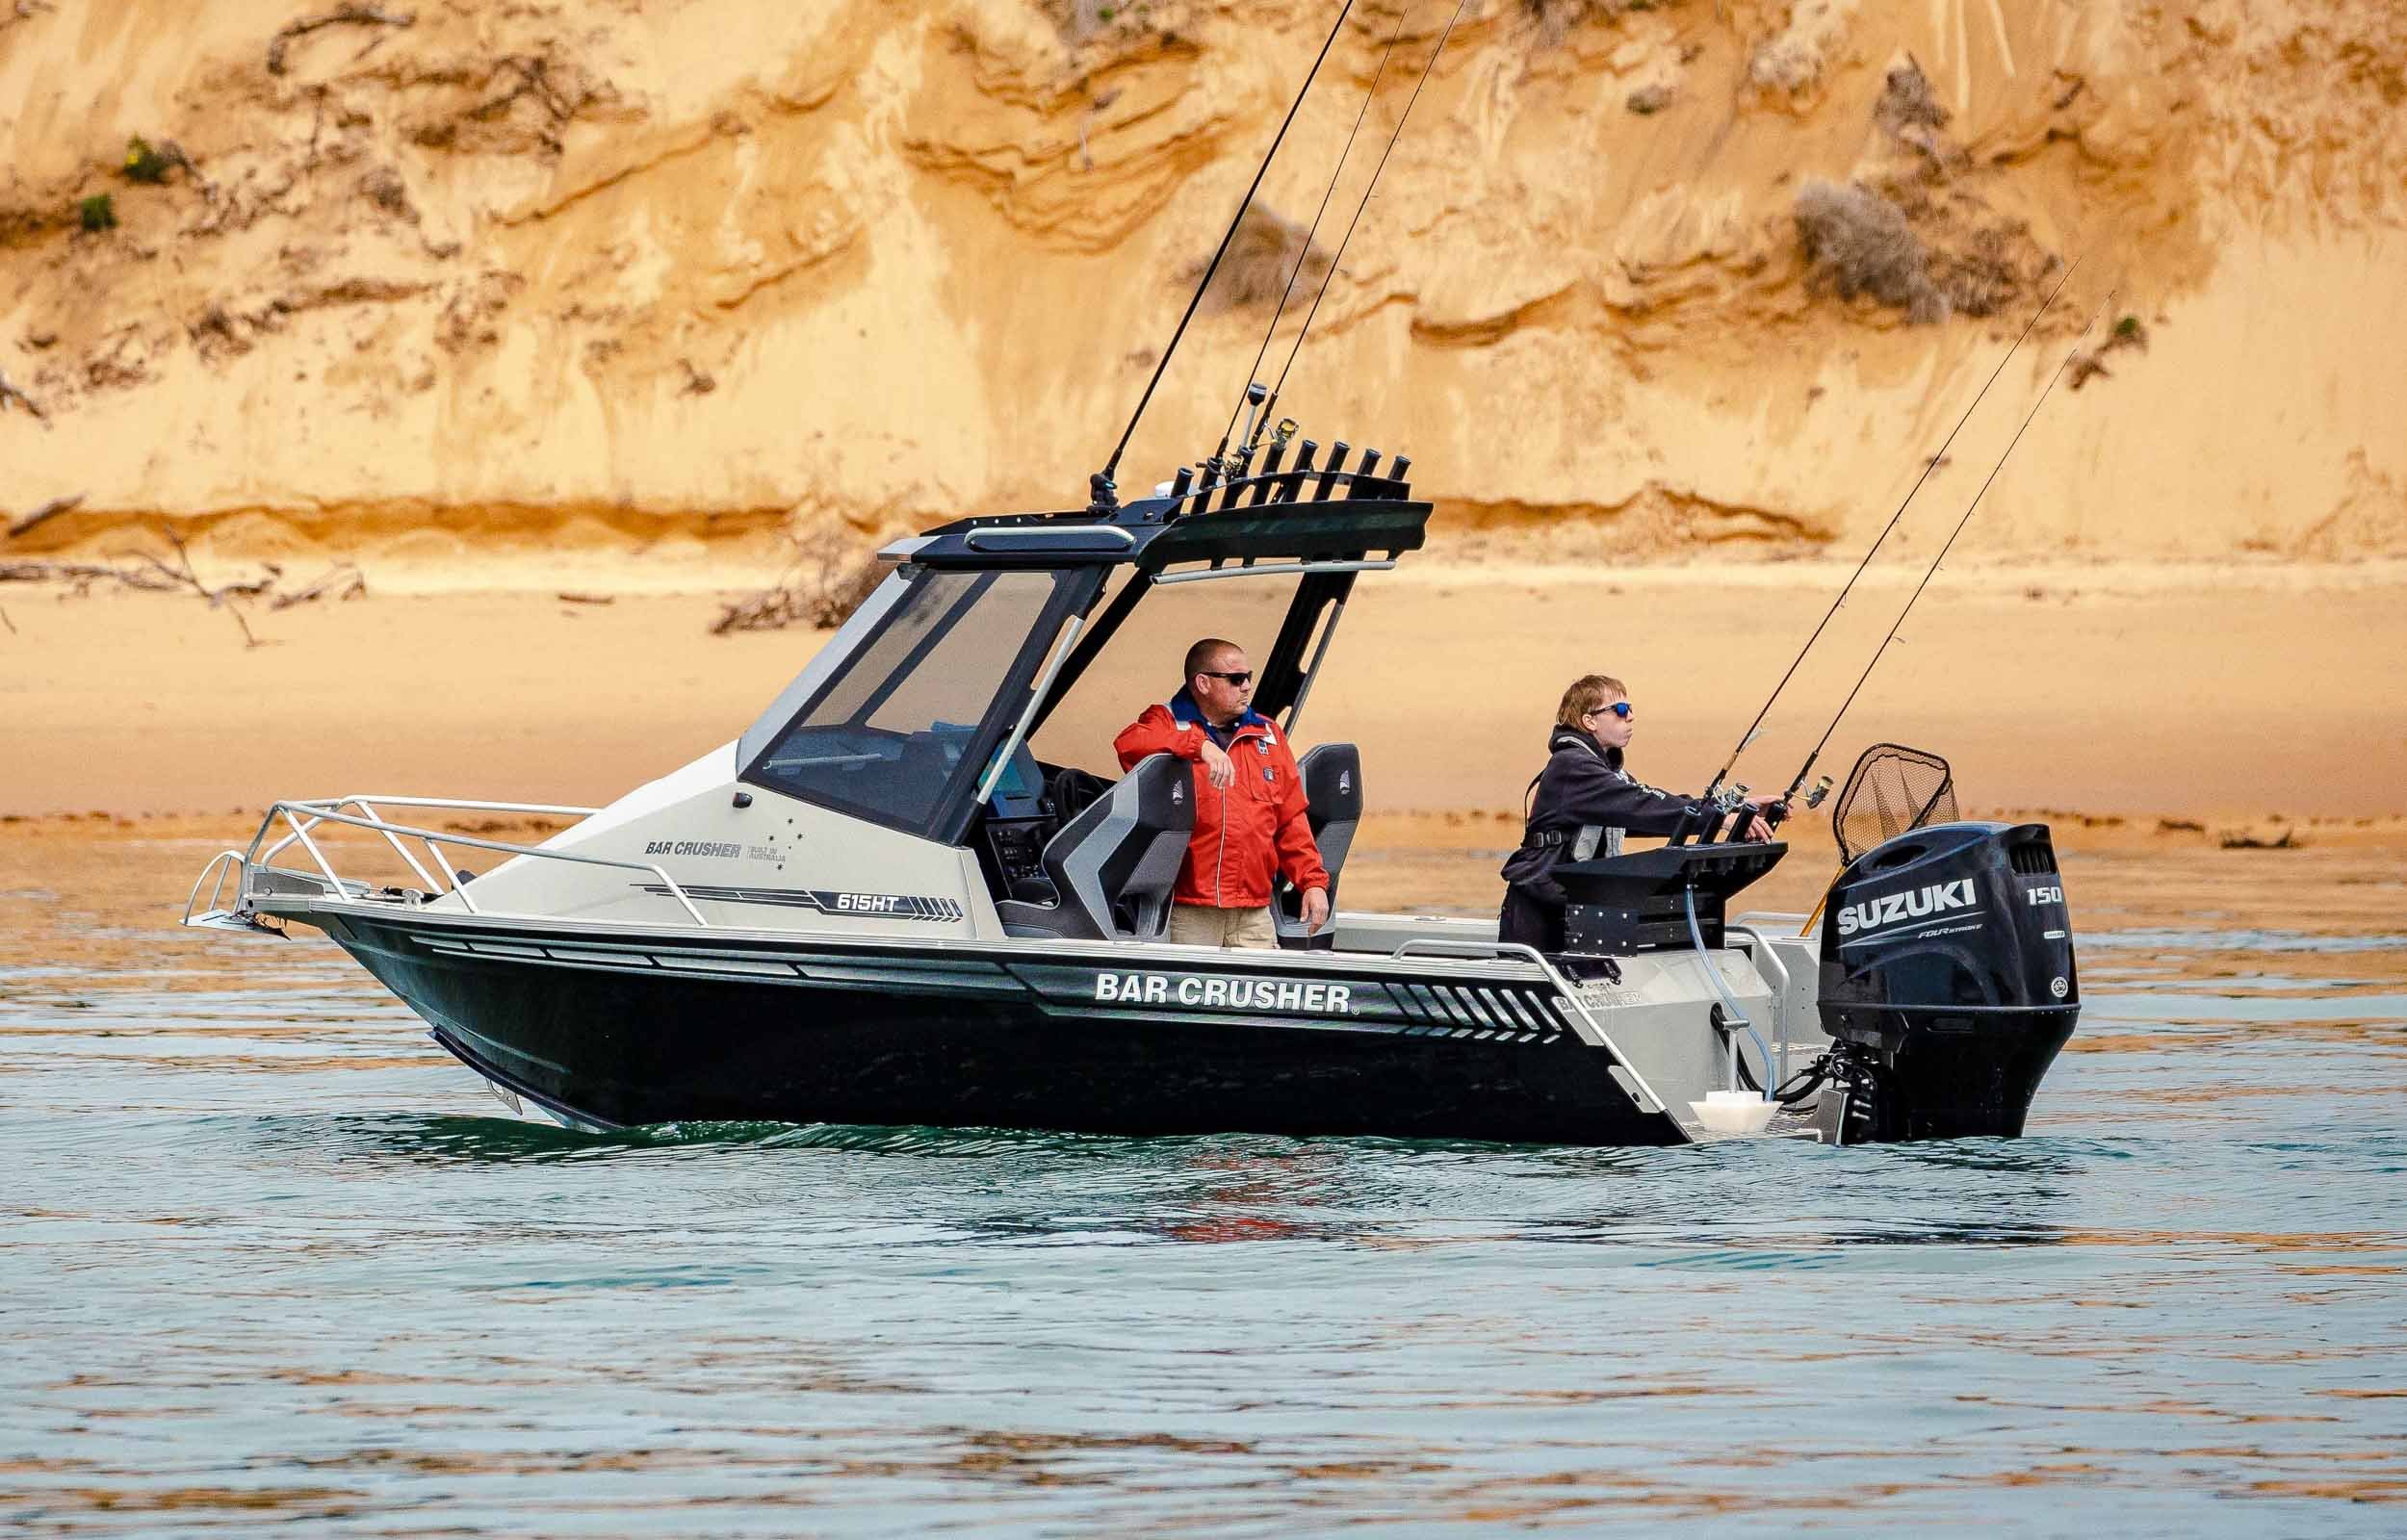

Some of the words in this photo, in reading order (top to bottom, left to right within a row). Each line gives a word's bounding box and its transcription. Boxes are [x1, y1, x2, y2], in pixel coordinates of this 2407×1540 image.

[645, 841, 673, 855] BAR
[674, 841, 741, 858] CRUSHER
[837, 893, 899, 912] 615HT
[2027, 886, 2062, 905] 150
[1837, 878, 1977, 936] SUZUKI
[1918, 927, 1949, 939] FOUR
[1095, 973, 1169, 1003] BAR
[1178, 977, 1351, 1014] CRUSHER
